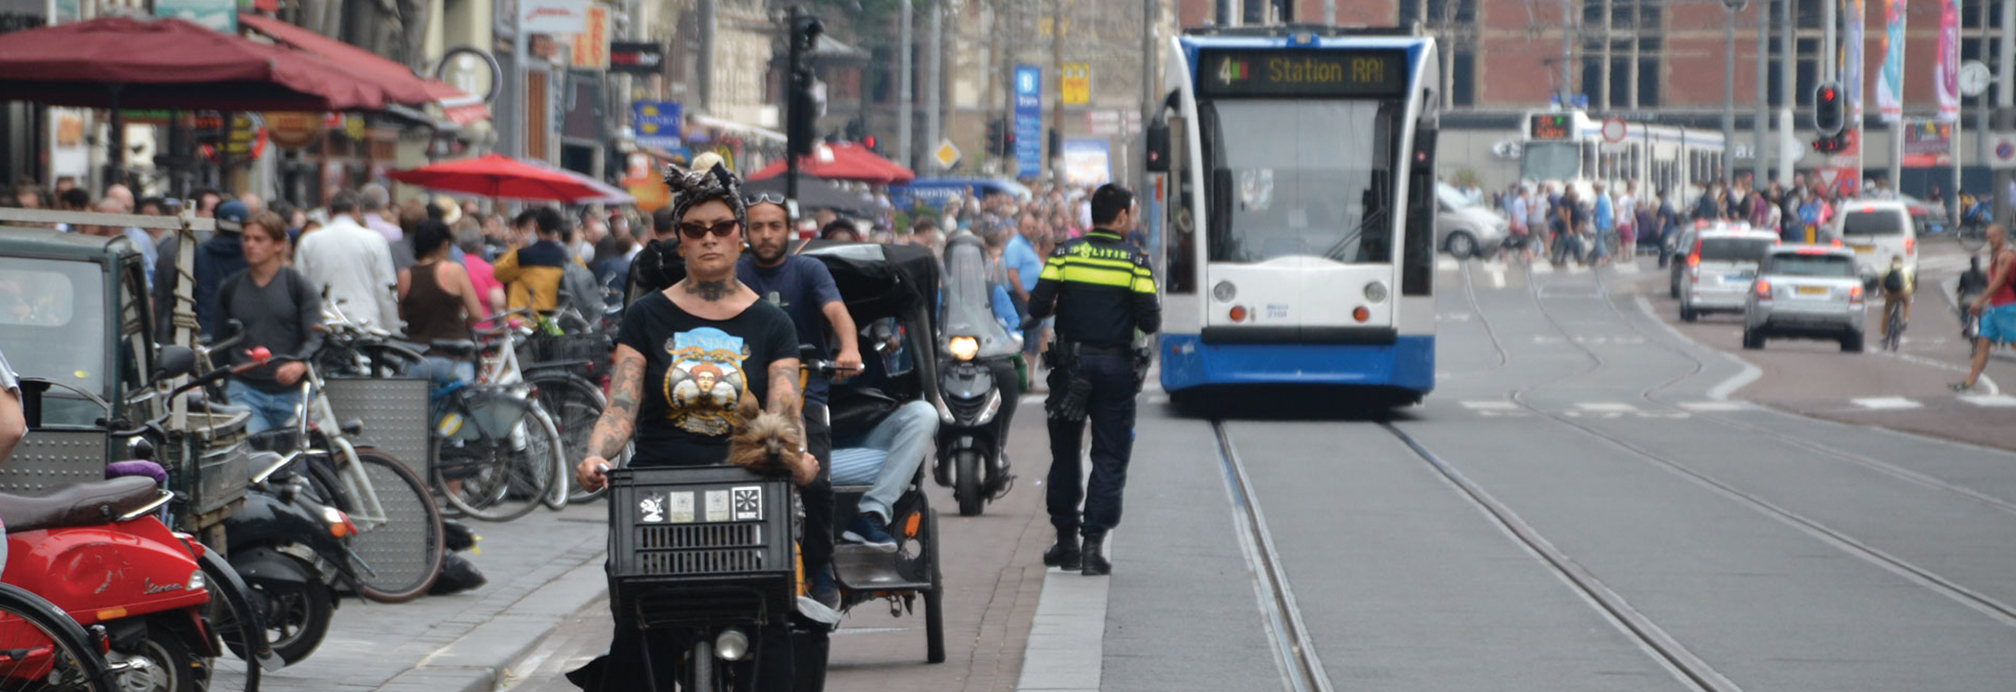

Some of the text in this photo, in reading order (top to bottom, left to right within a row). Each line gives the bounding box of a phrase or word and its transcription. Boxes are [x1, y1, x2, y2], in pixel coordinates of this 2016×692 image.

[1218, 56, 1232, 85] 4
[1270, 58, 1384, 82] Station RAI
[1073, 242, 1127, 259] POLITIE
[676, 332, 740, 350] LONDON
[144, 577, 183, 594] Vespa
